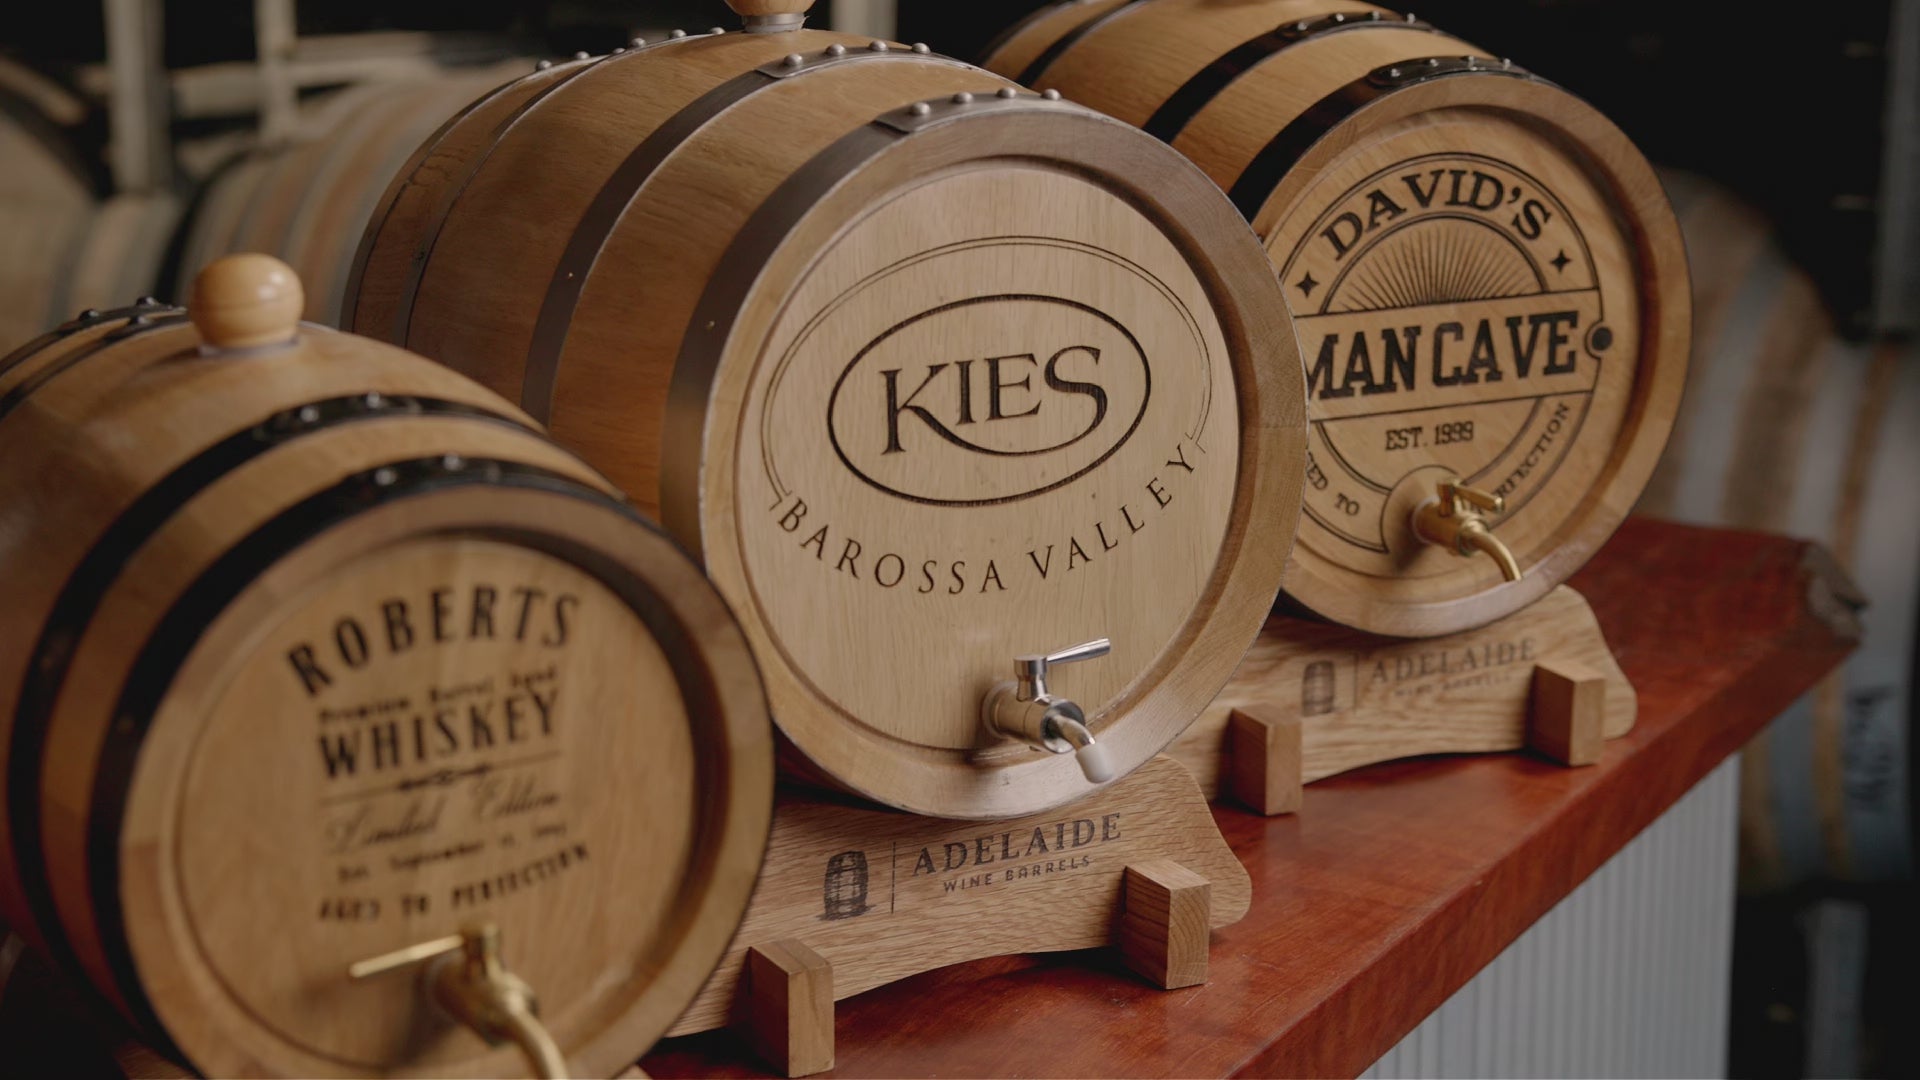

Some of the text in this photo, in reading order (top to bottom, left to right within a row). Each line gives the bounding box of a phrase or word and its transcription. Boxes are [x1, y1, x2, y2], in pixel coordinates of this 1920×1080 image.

[1319, 168, 1552, 261] DAVID'S
[1432, 310, 1579, 388] CAVE
[879, 345, 1108, 456] KIES
[1385, 421, 1474, 451] EST. 1999
[777, 444, 1196, 595] BAROSSA VALLEY
[1334, 492, 1360, 516] TO
[287, 583, 580, 697] ROBERTS
[1372, 638, 1536, 682] ADELAIDE
[318, 689, 559, 779] WHISKEY
[453, 843, 589, 907] PERFECTION
[911, 812, 1122, 877] ADELAIDE
[943, 855, 1090, 893] WINE BARRELS
